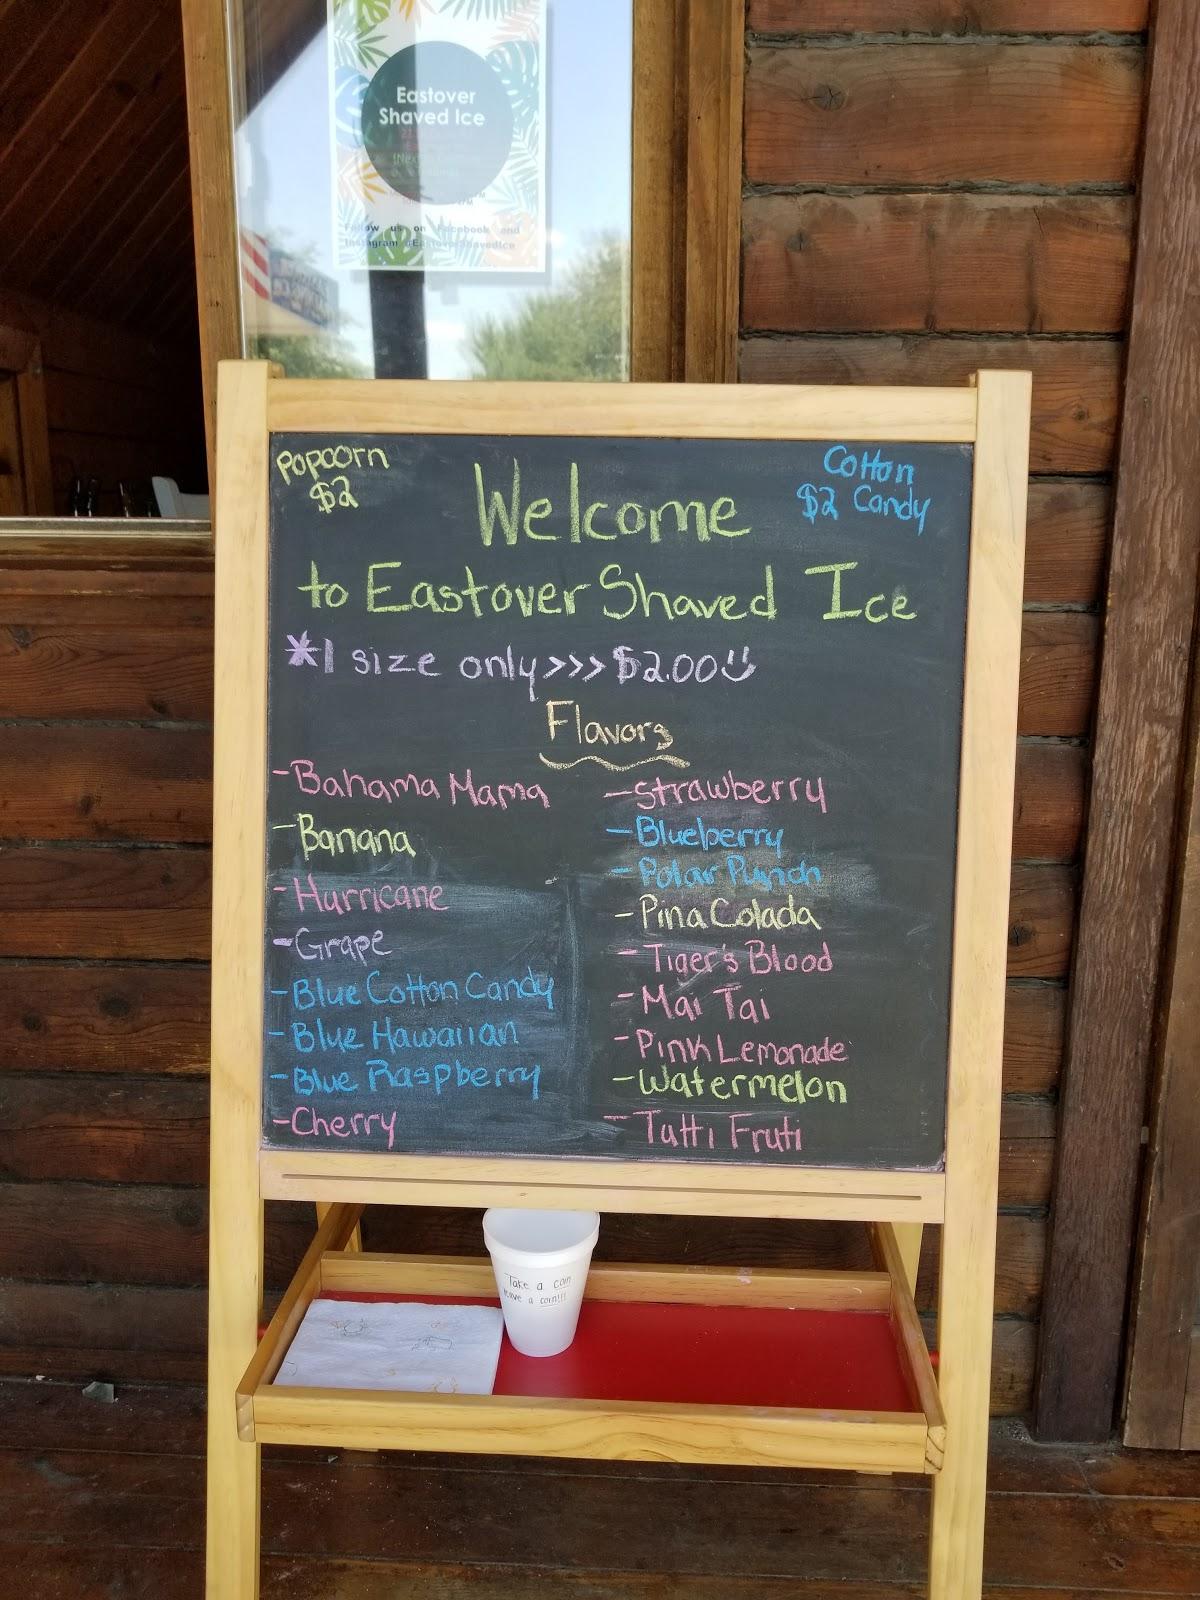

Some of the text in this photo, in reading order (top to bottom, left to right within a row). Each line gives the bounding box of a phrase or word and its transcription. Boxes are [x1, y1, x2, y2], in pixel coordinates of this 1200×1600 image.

[397, 86, 477, 105] Eastover
[378, 107, 486, 127] Shaved Ice
[823, 445, 915, 484] Cotton
[309, 476, 359, 514] $2
[474, 458, 752, 547] Welcome
[797, 483, 931, 536] $2 Candy
[297, 560, 918, 623] to Eastover Shaved Ice
[352, 647, 442, 677] size
[459, 645, 538, 702] only
[612, 645, 719, 685] $2.00
[546, 700, 674, 750] Flavors
[449, 769, 551, 810] Mama
[710, 894, 823, 931] Colada
[745, 939, 834, 975] Blood
[366, 970, 459, 1008] Cotton
[465, 966, 555, 1010] Candy
[713, 982, 771, 1024] Tai
[372, 1016, 520, 1054] Hawaiian
[717, 1033, 849, 1067] Lemonade
[366, 1059, 541, 1101] Raspberry
[504, 1272, 530, 1290] Take
[536, 1282, 543, 1291] a
